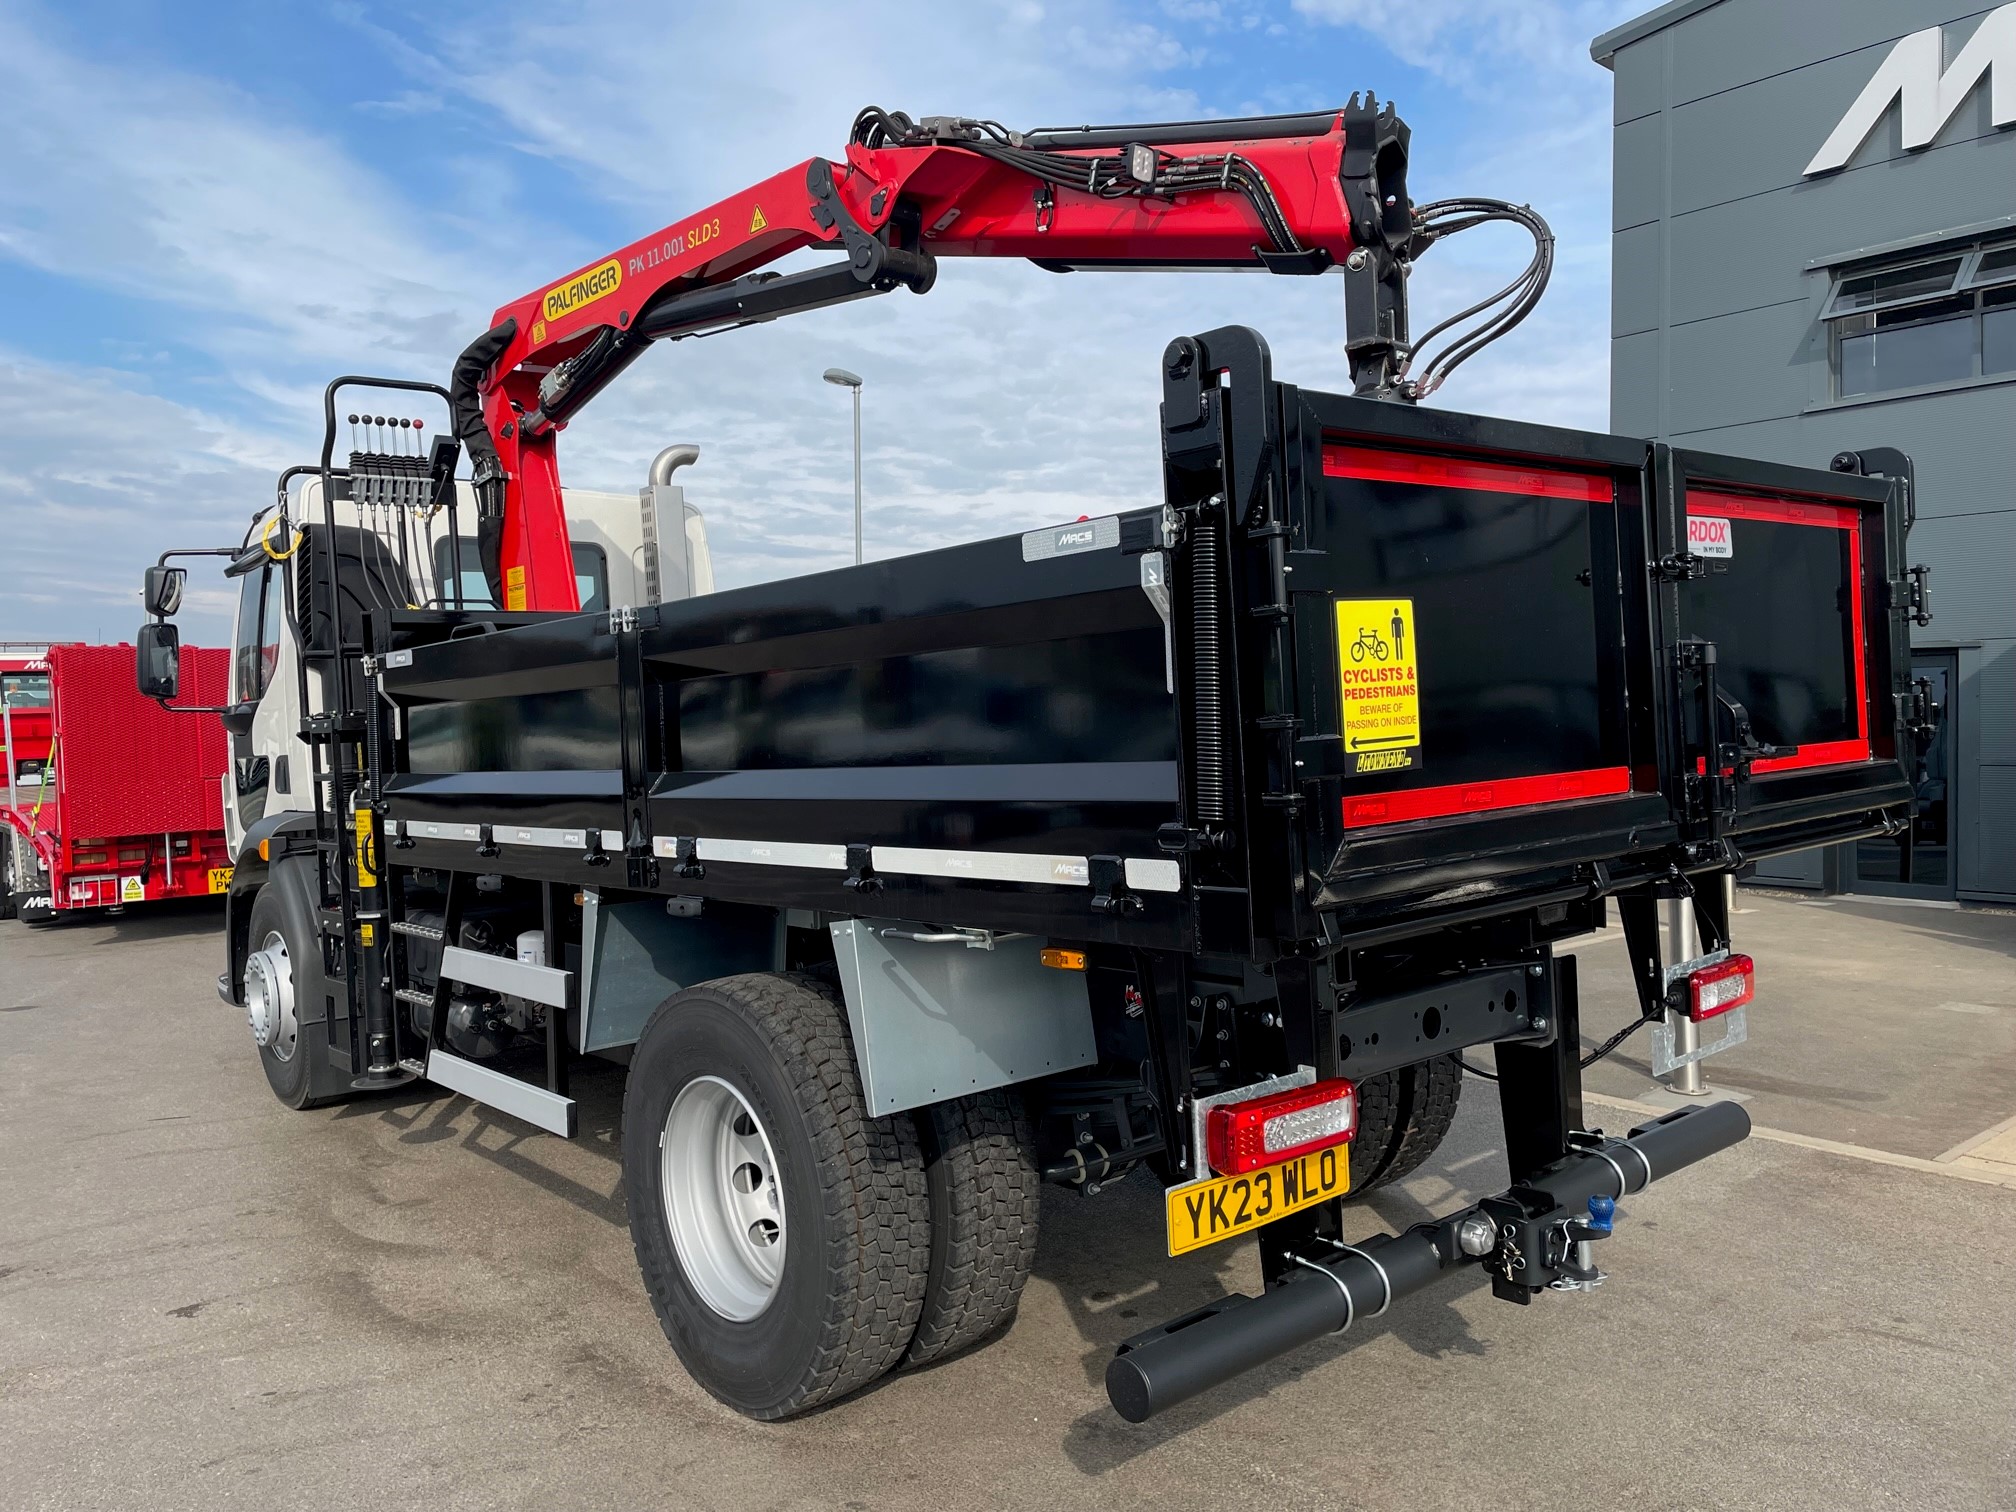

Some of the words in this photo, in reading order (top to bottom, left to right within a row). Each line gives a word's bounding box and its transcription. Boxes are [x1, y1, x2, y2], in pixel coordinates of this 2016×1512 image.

[629, 255, 645, 276] PK
[647, 236, 685, 267] 11.001
[547, 265, 617, 317] PALFINGER
[1058, 530, 1093, 546] MACS
[1689, 520, 1726, 543] RDOX
[1343, 667, 1403, 684] CYCLISTS
[1406, 667, 1415, 680] &
[1344, 684, 1416, 700] PEDESTRIANS
[1359, 704, 1392, 715] BEWARE
[1393, 703, 1403, 712] OF
[1346, 717, 1379, 730] PASSING
[1381, 716, 1392, 727] ON
[1393, 715, 1417, 726] INSIDE
[212, 869, 234, 880] YK2
[1055, 863, 1088, 875] MACS
[216, 881, 231, 891] PW
[1185, 1172, 1272, 1239] YK23
[1281, 1149, 1336, 1207] WLO
